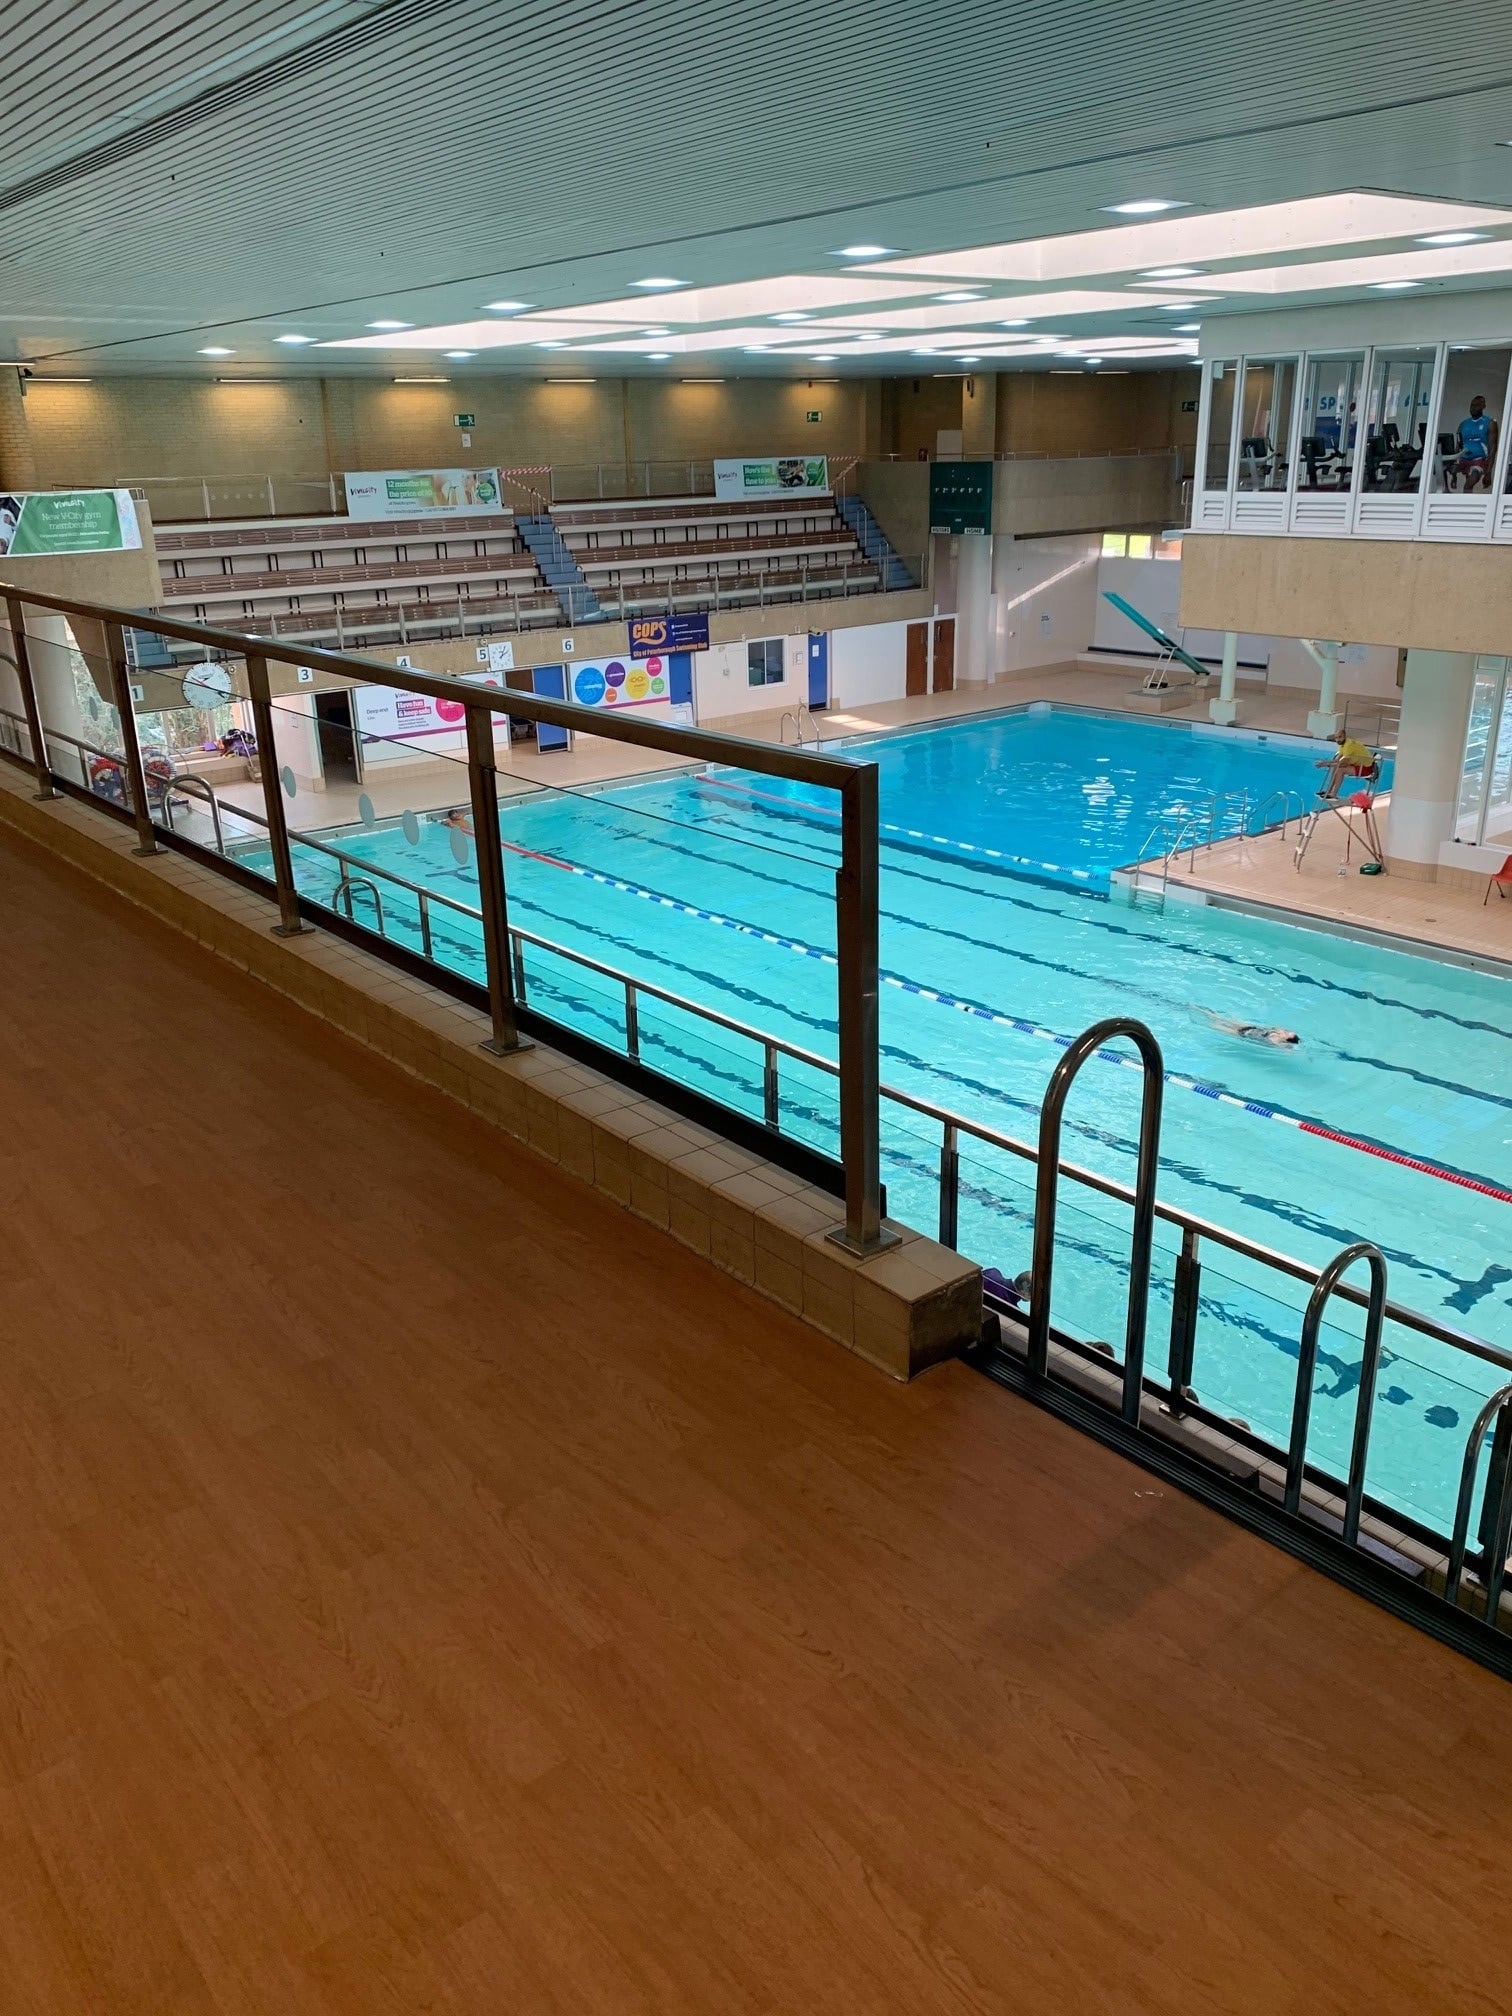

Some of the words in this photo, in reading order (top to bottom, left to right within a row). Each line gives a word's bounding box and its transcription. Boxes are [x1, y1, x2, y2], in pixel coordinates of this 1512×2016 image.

[387, 480, 395, 488] 12
[350, 486, 377, 496] Vivacity
[400, 490, 417, 499] price
[53, 500, 85, 509] Vivacity
[41, 513, 59, 521] New
[84, 511, 101, 521] gym
[49, 521, 97, 530] membership
[632, 621, 667, 643] COPS
[564, 640, 572, 651] 6
[479, 649, 487, 660] 5
[633, 650, 642, 658] City
[400, 658, 407, 667] 4
[301, 669, 309, 681] 3
[132, 688, 139, 700] 1
[397, 701, 413, 710] Have
[413, 700, 424, 709] fun
